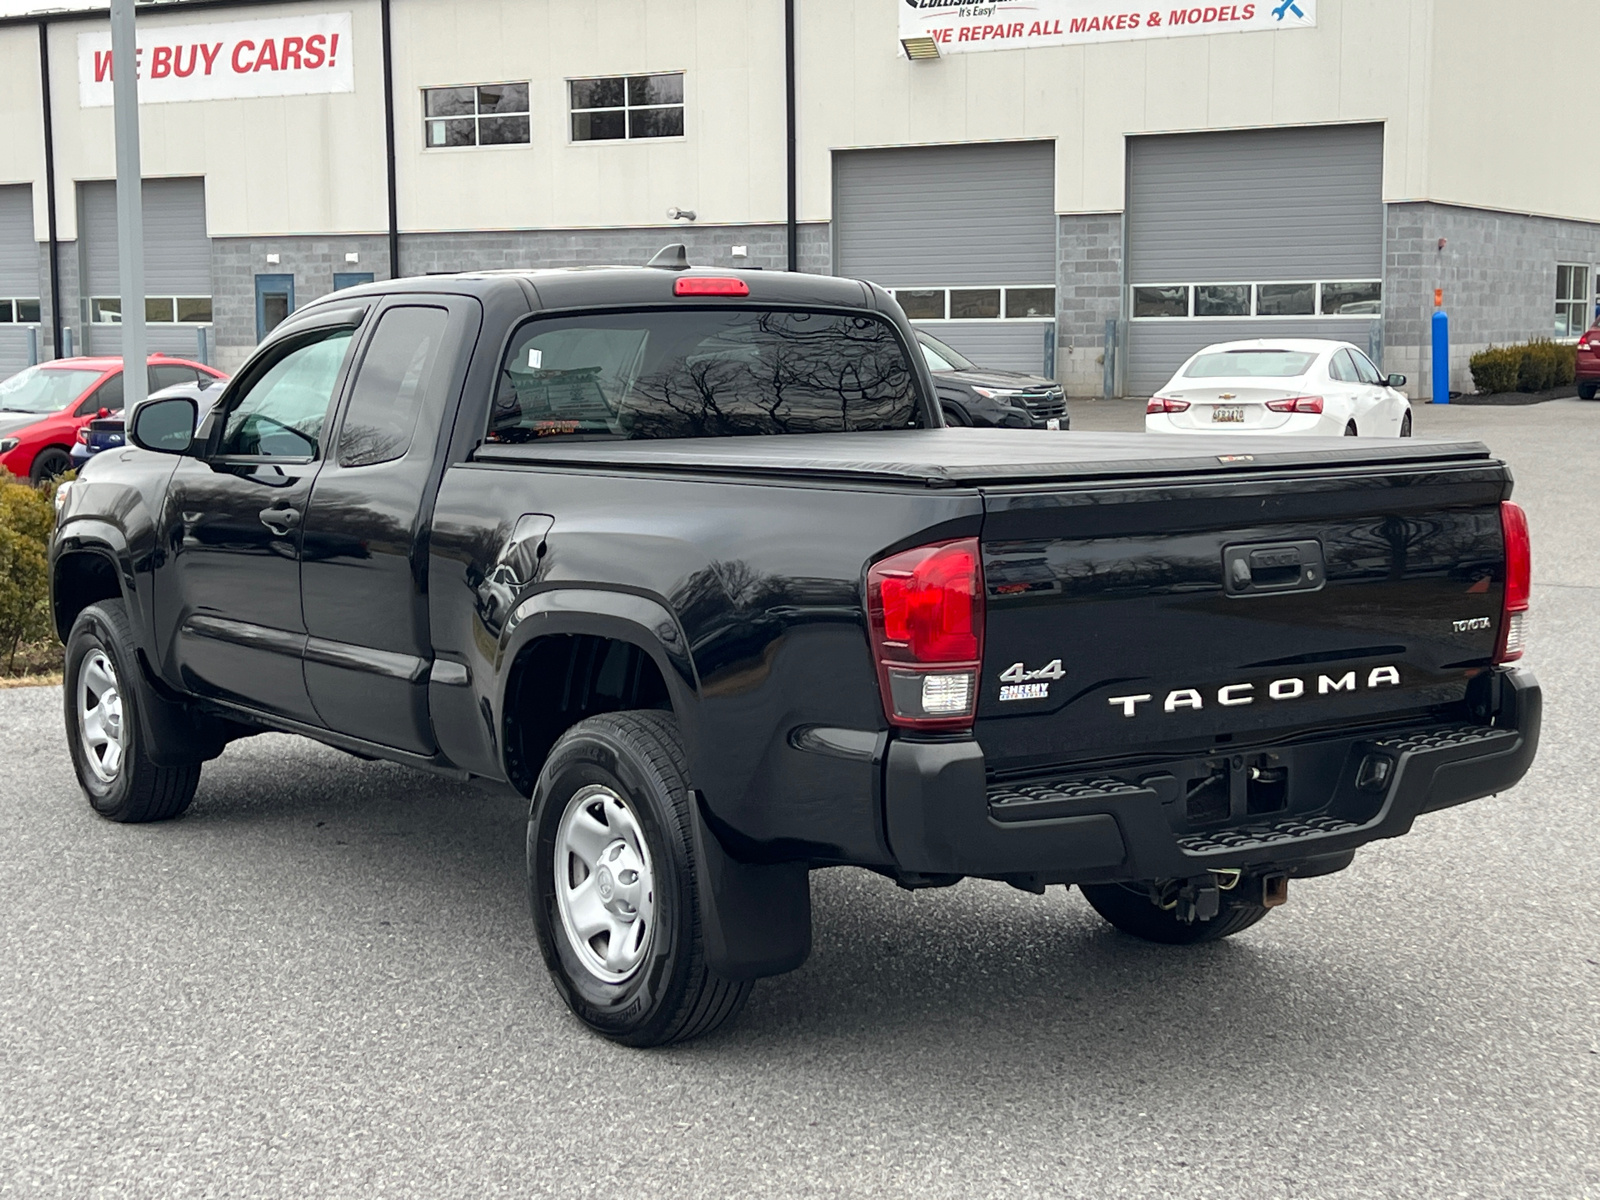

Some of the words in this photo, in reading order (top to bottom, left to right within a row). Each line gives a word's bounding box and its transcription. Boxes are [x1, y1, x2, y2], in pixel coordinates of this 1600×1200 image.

[958, 7, 971, 18] It's
[973, 4, 997, 17] Easy!
[958, 22, 1024, 42] REPAIR
[1028, 19, 1063, 37] ALL
[1069, 13, 1140, 33] MAKES
[1146, 11, 1162, 28] &
[1168, 3, 1255, 26] MODELS
[95, 48, 142, 82] W
[151, 42, 223, 79] BUY
[231, 33, 340, 74] CARS!
[1452, 616, 1491, 632] TOYOTA
[999, 659, 1066, 683] 4x4
[1000, 683, 1049, 695] SHEEHY
[1108, 665, 1402, 717] TACOMA
